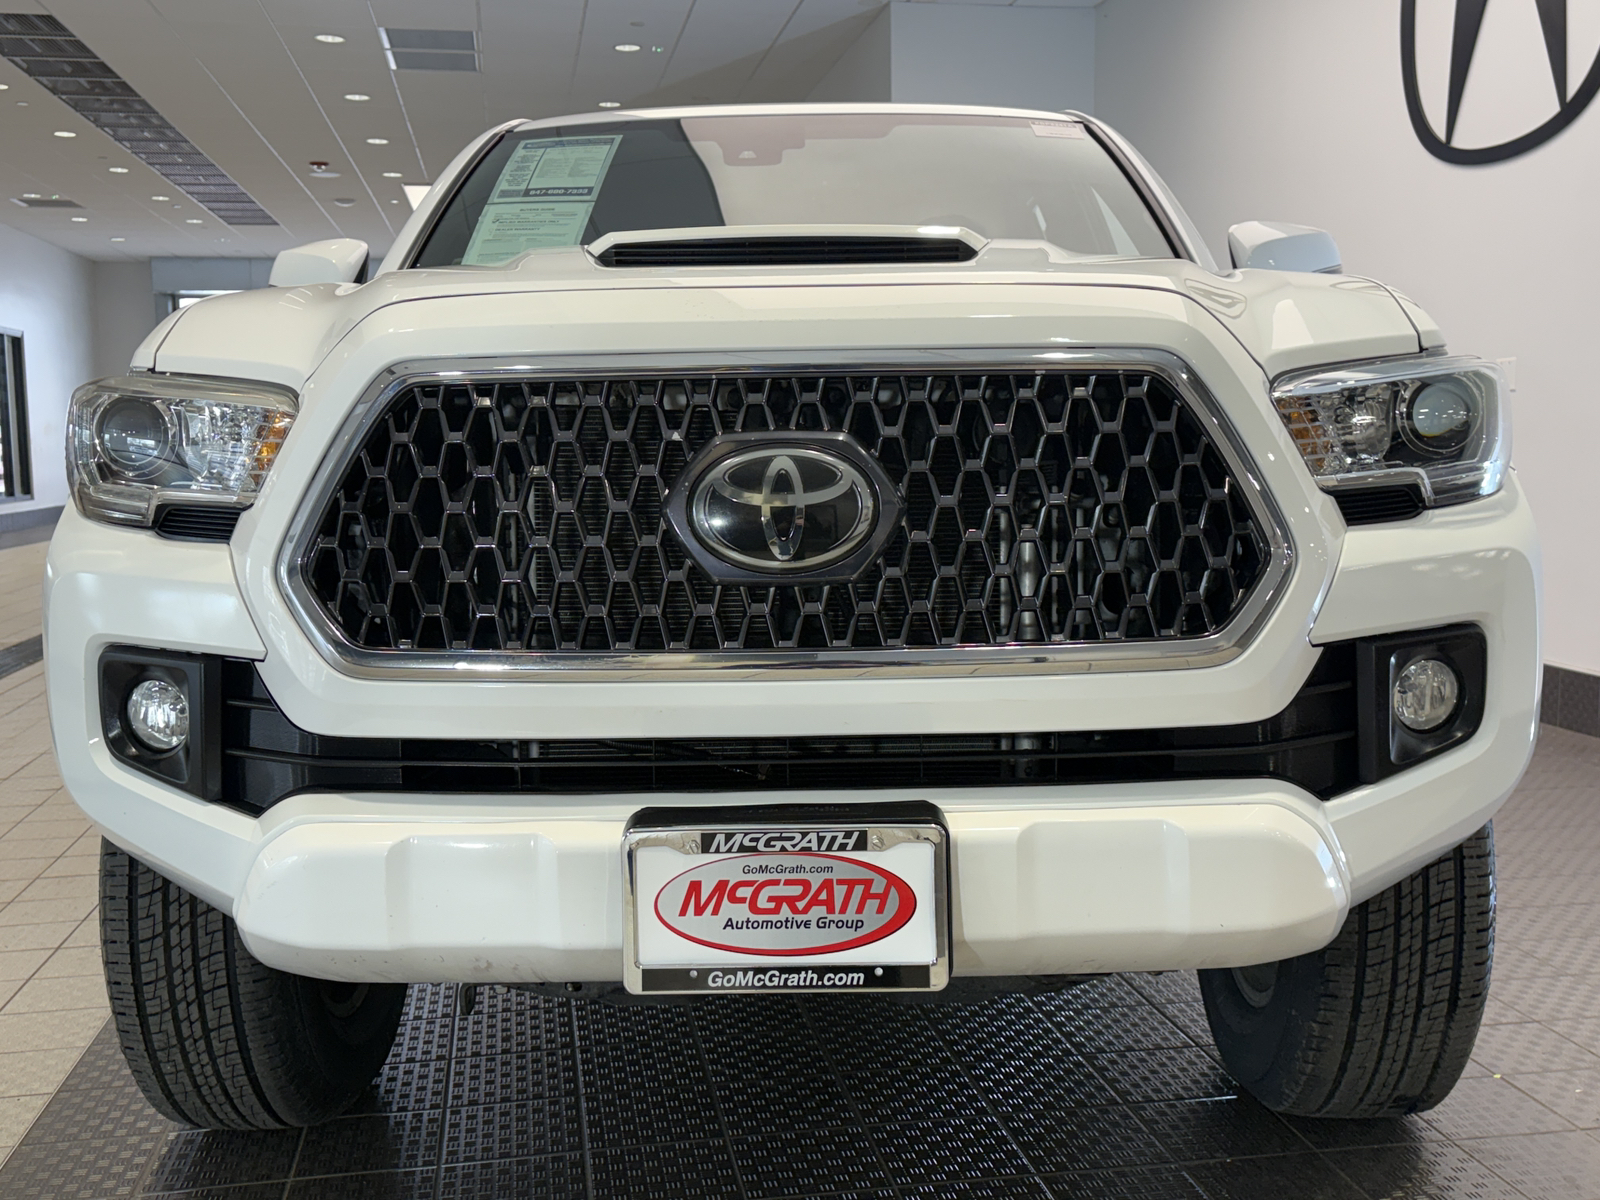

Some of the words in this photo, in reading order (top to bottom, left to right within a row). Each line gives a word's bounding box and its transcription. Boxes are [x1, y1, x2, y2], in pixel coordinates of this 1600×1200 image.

[742, 863, 834, 876] GoMcGrath.com
[722, 916, 812, 931] Automotive
[815, 916, 865, 932] Group
[707, 969, 865, 988] GoMcGrath.com
